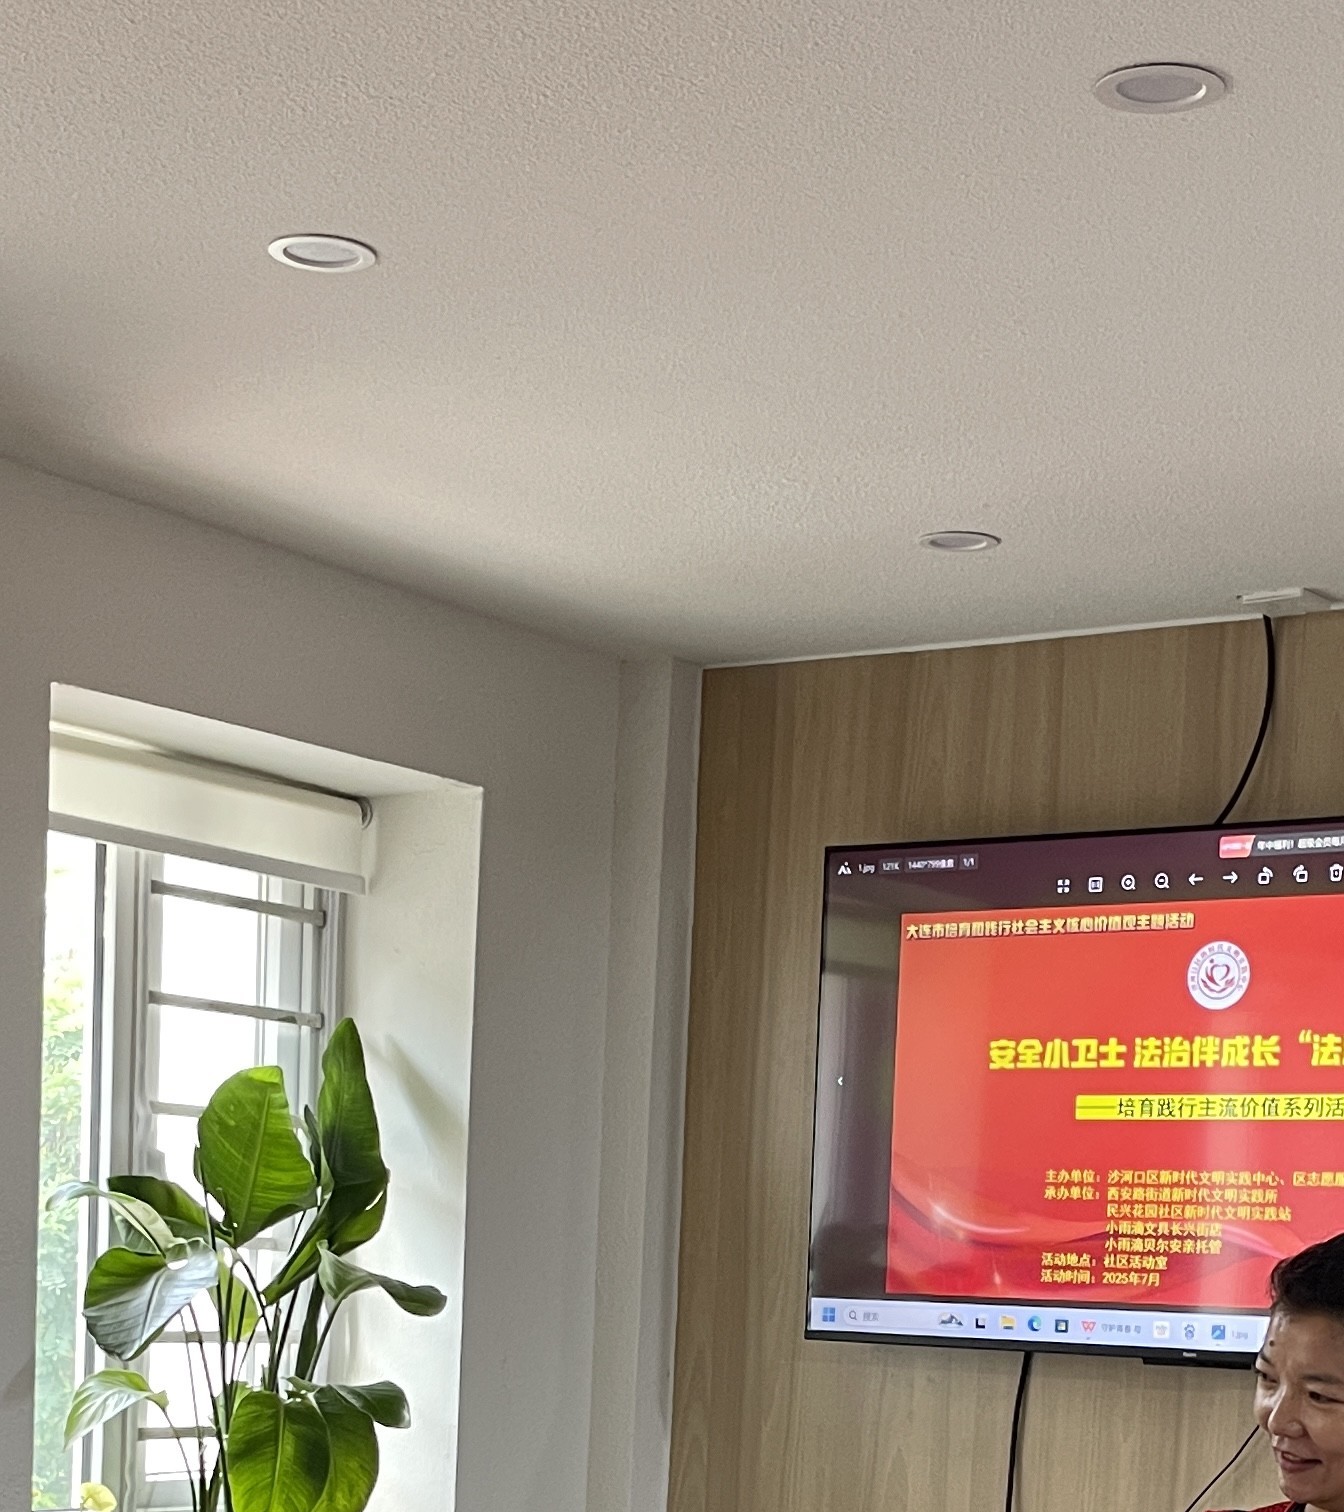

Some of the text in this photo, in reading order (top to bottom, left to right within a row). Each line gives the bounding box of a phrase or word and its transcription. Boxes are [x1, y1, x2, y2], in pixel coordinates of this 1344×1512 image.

[988, 1038, 1127, 1070] 安全小卫士
[1133, 1034, 1282, 1069] 法治伴成长
